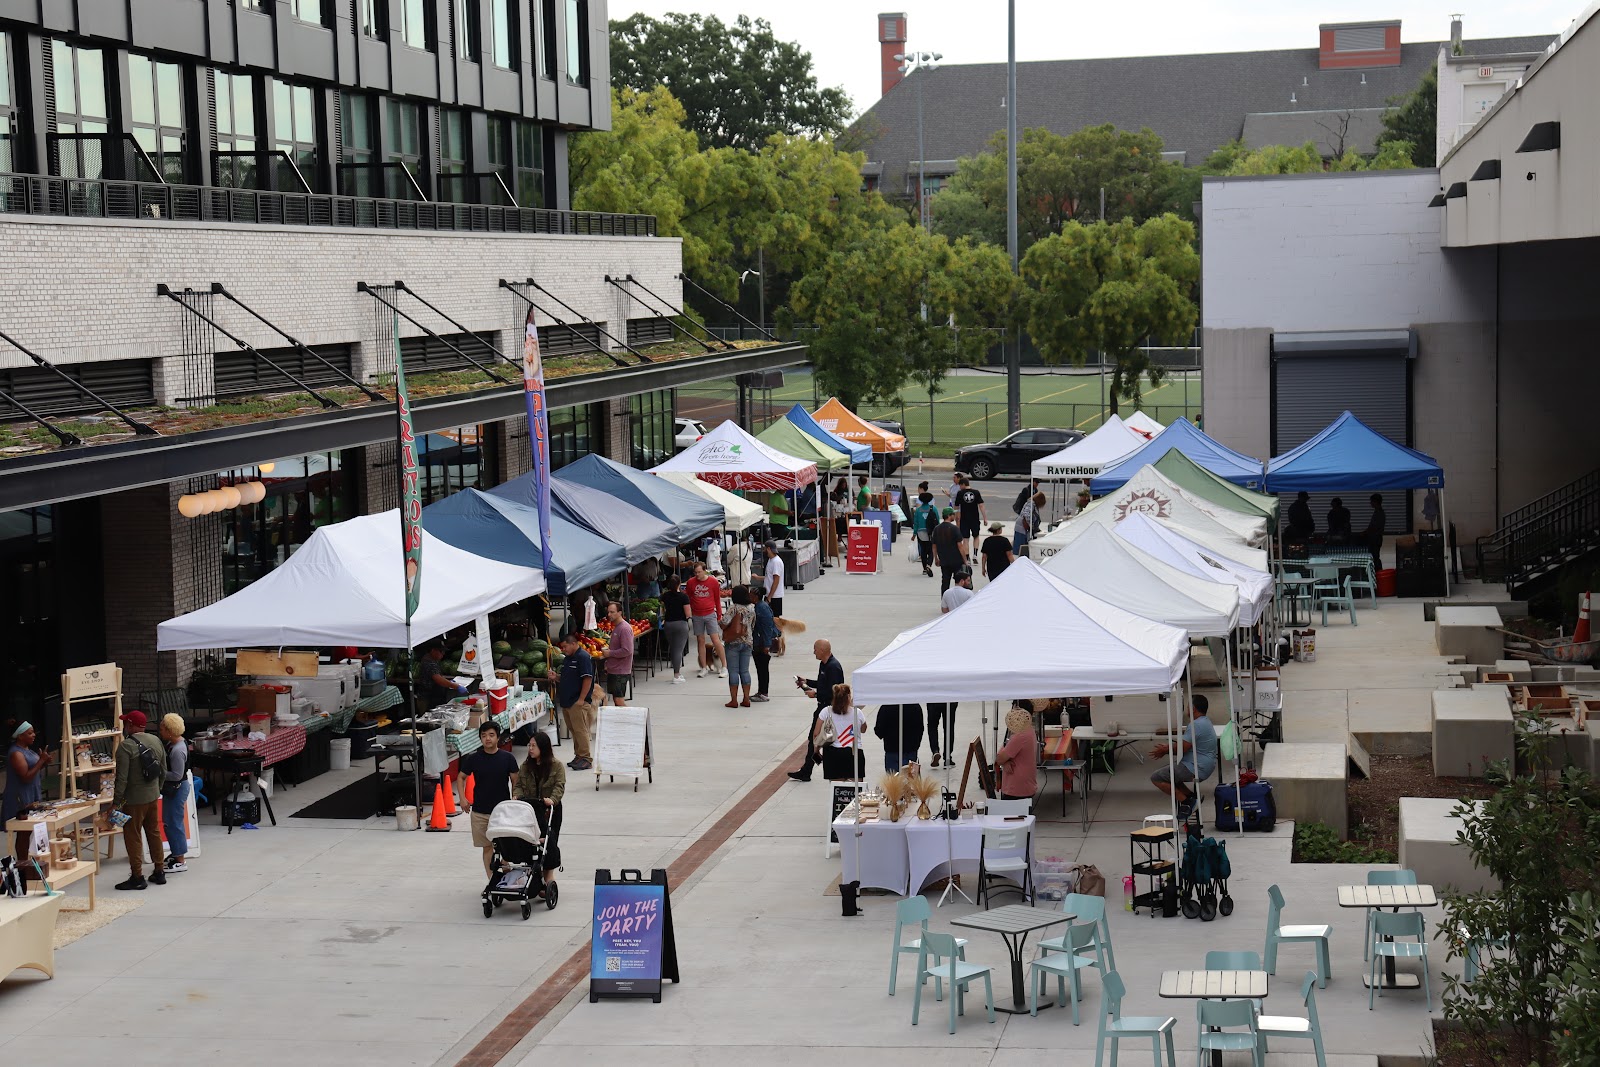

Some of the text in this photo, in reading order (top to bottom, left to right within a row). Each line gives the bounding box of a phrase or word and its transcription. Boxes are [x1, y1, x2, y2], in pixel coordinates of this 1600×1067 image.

[1130, 504, 1155, 514] HEX
[597, 898, 659, 921] JOIN THE
[600, 914, 657, 938] PARTY
